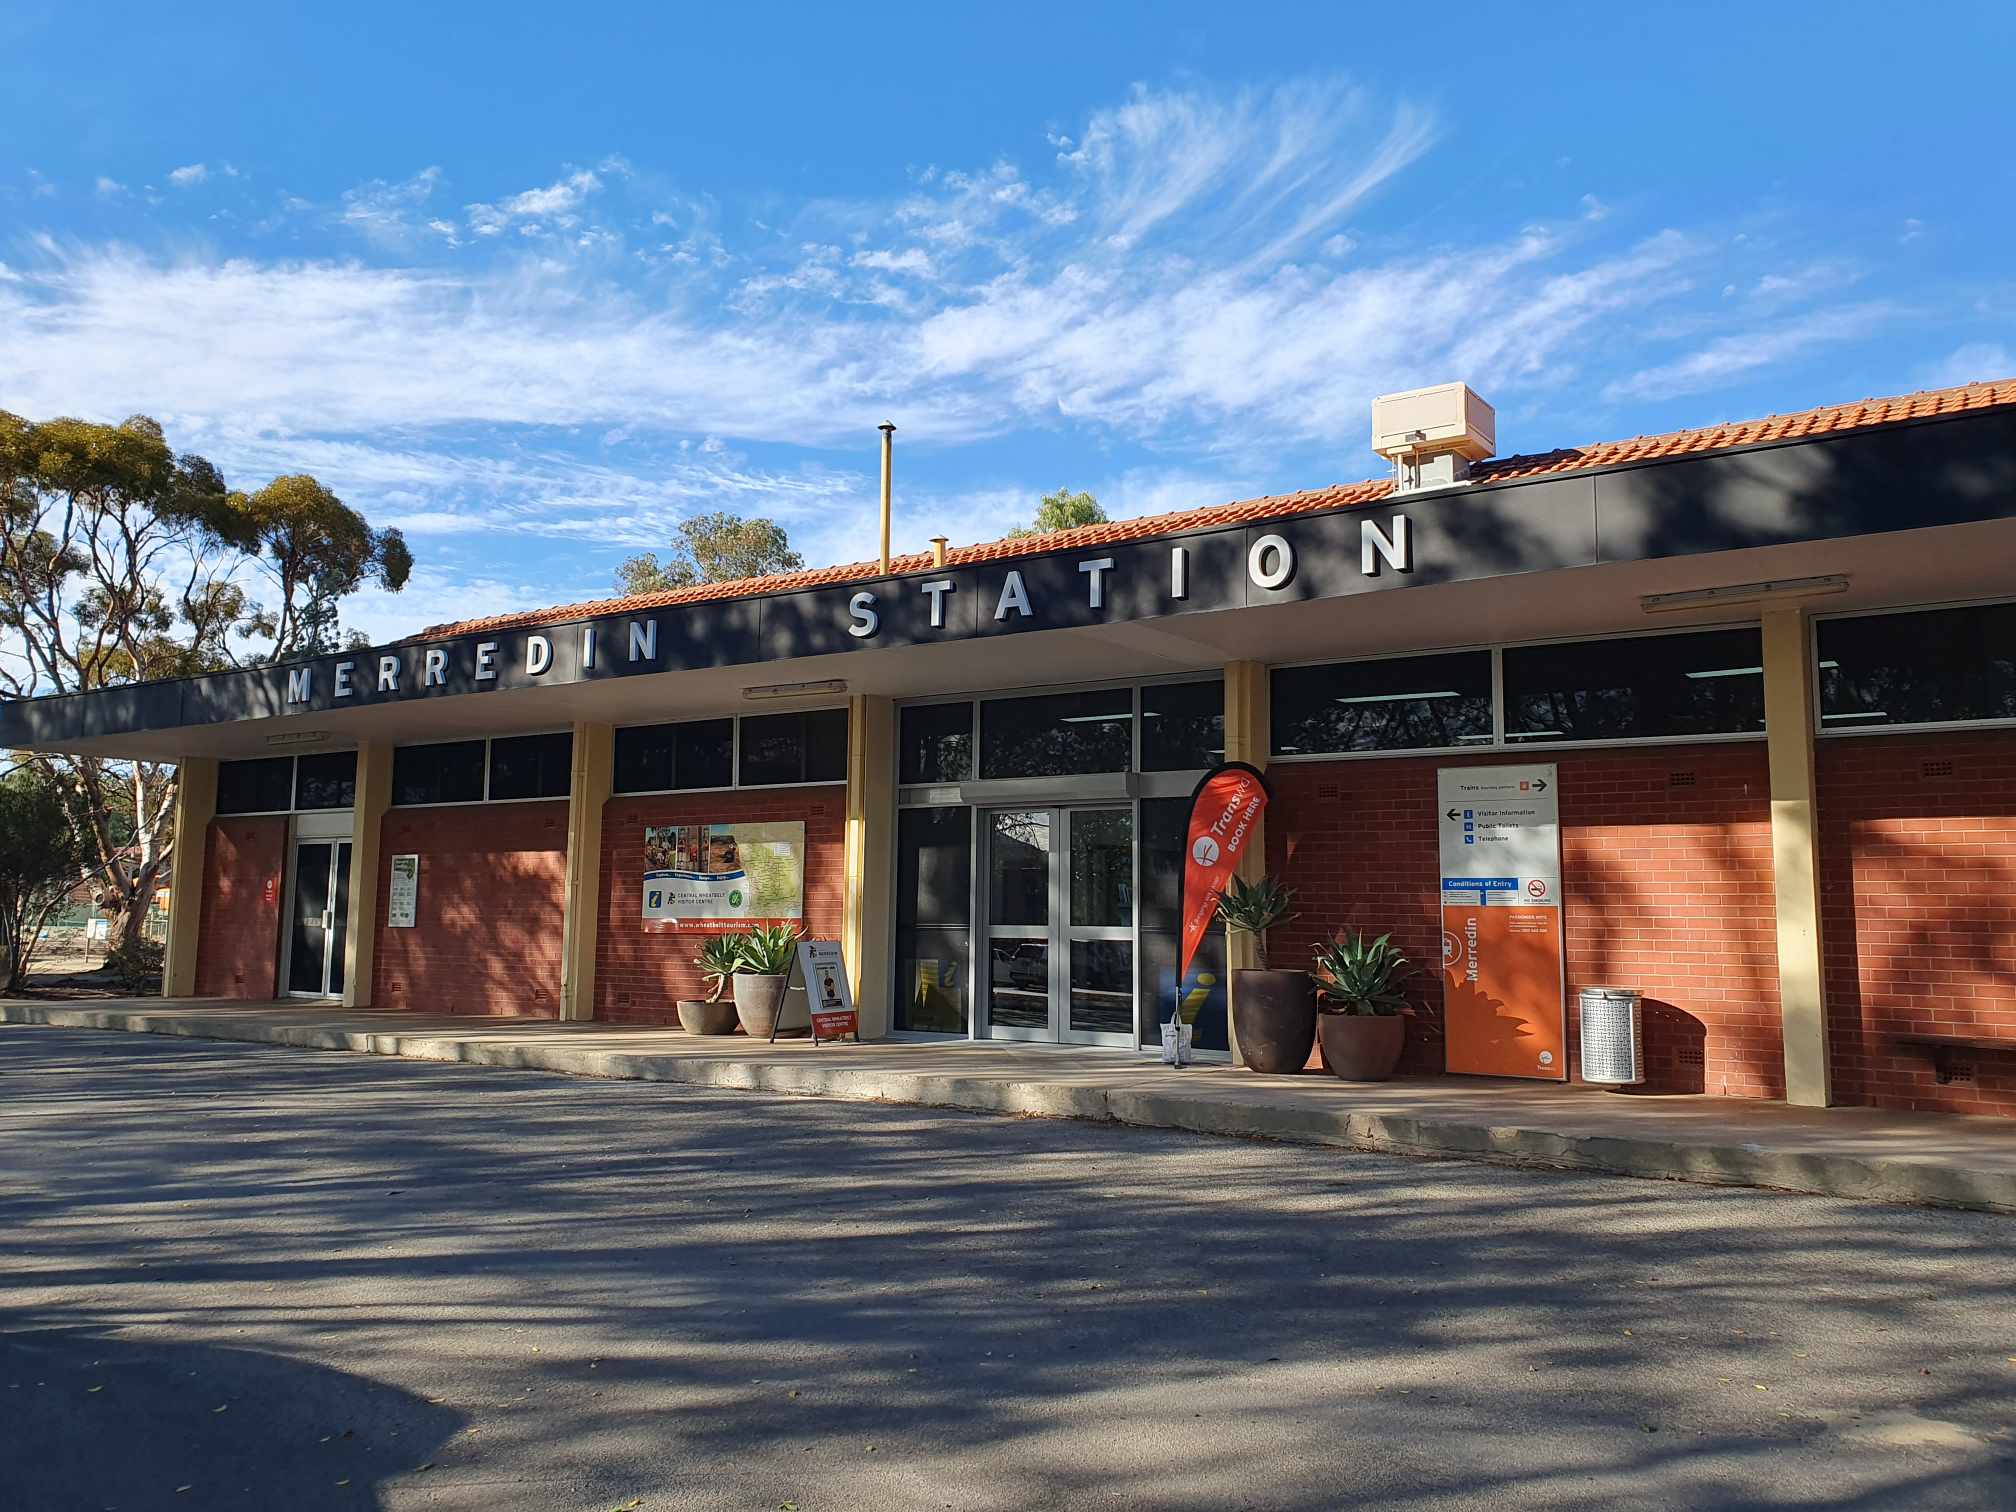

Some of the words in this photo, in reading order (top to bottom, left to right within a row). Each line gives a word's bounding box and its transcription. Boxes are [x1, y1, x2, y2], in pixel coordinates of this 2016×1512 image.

[287, 619, 658, 703] MERREDIN
[847, 514, 1408, 638] STATION
[1210, 776, 1251, 836] Transwa
[1227, 819, 1248, 853] BOOK
[1243, 795, 1261, 822] HERE
[1448, 880, 1483, 888] Conditions
[1484, 880, 1491, 888] of
[1493, 880, 1513, 889] Entry
[1465, 917, 1479, 981] Merredin
